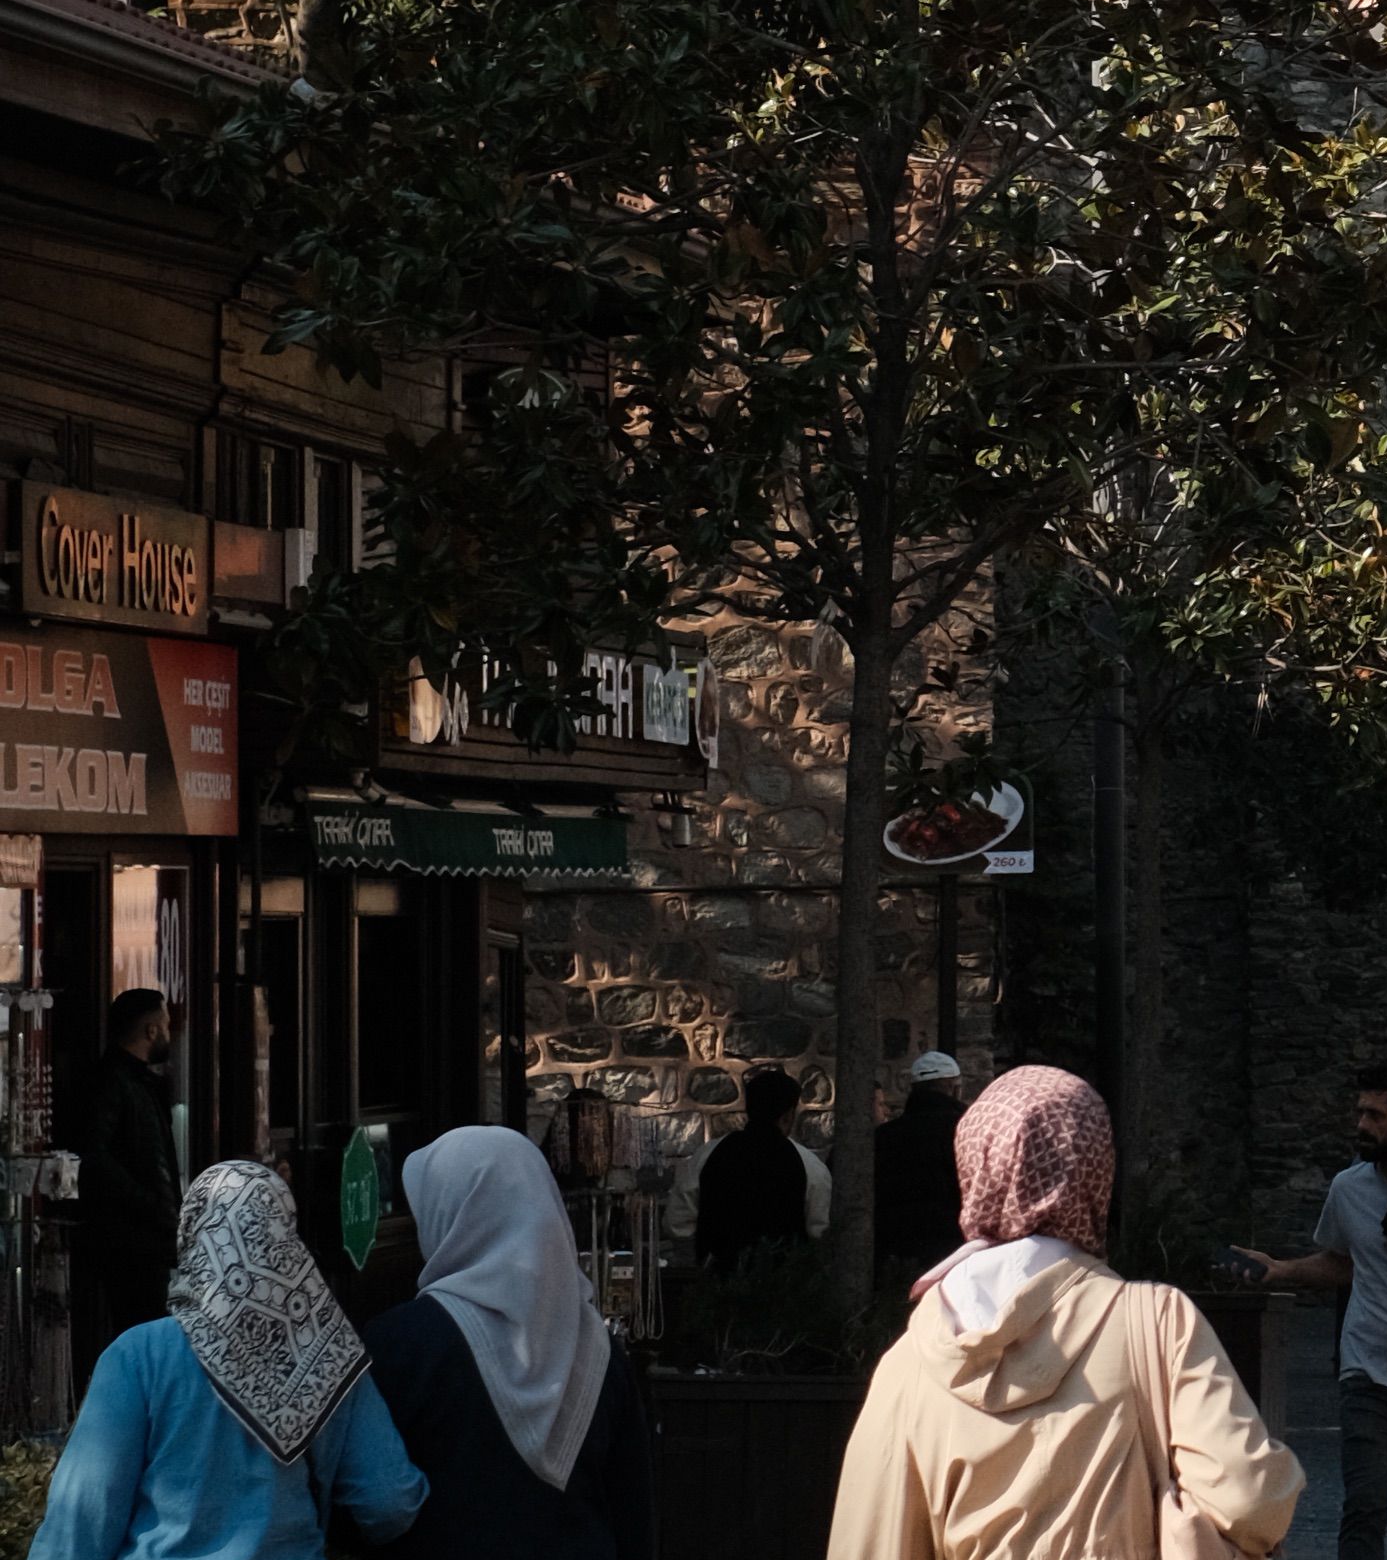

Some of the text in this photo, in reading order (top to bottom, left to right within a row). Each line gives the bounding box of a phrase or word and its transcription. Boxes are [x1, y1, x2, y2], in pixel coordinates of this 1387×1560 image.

[39, 494, 198, 618] Cover House
[190, 725, 224, 755] MODEL
[993, 856, 1016, 867] 260
